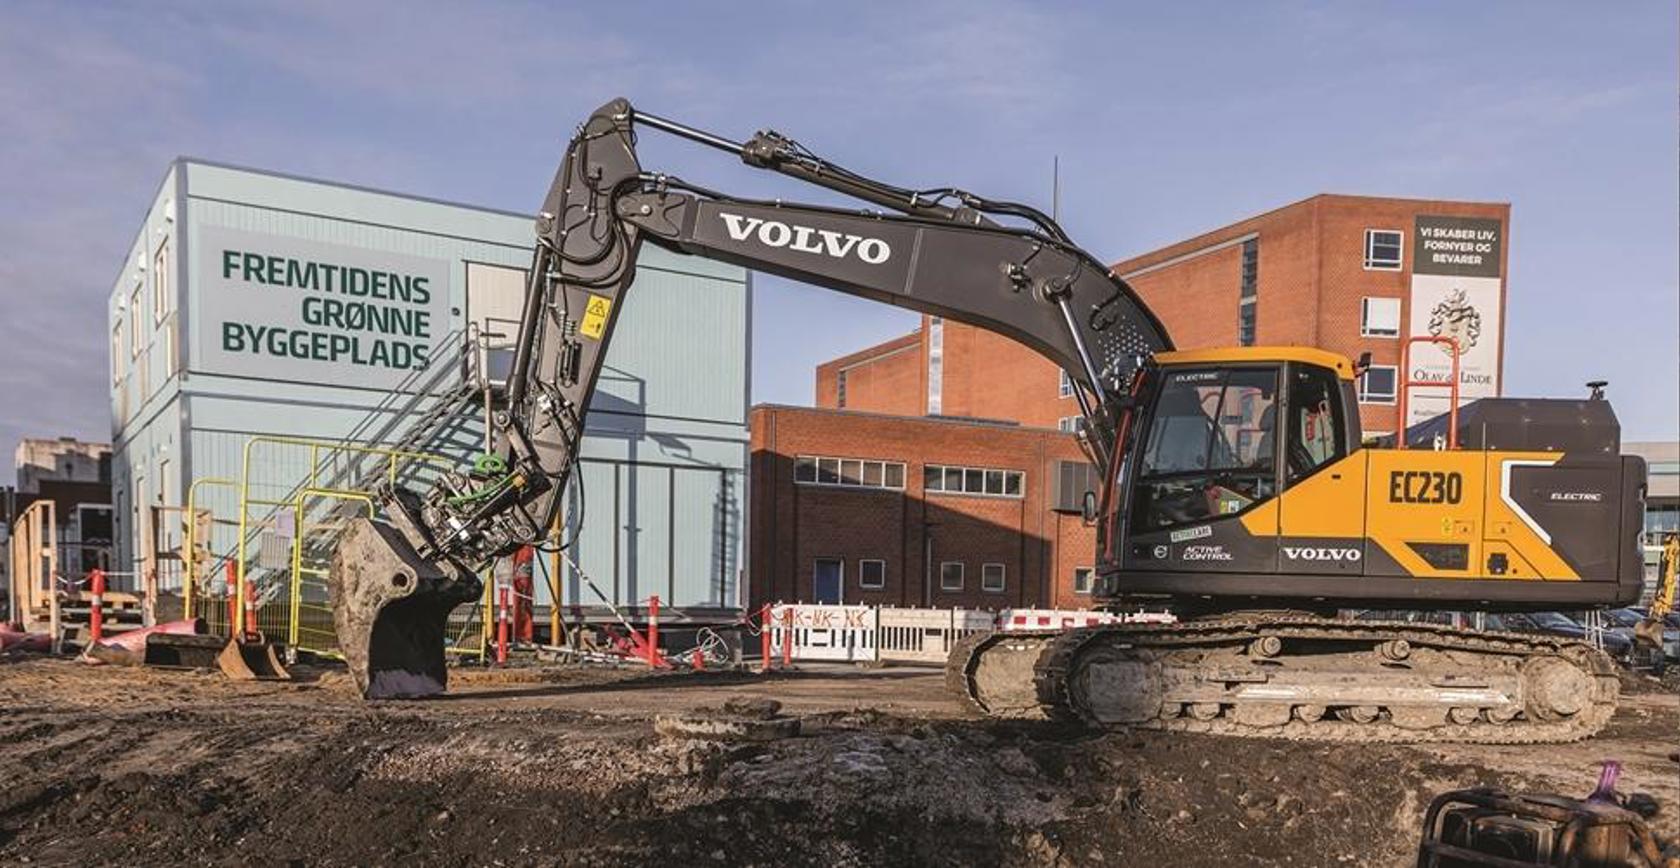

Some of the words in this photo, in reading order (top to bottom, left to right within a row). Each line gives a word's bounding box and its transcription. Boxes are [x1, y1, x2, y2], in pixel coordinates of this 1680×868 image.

[719, 212, 891, 265] VOLVO
[1420, 227, 1432, 237] VI
[1433, 228, 1475, 239] SKABER
[1477, 230, 1496, 242] LIV,
[1424, 240, 1474, 252] FORNYER
[1475, 243, 1491, 252] OG
[1432, 253, 1482, 265] BEVARER
[223, 249, 431, 305] FREMTIDENS
[302, 296, 431, 338] GRØNNE
[222, 321, 431, 371] BYGGEPLADS
[1175, 372, 1219, 382] ELECTRIC
[1389, 470, 1462, 504] EC230
[1550, 492, 1602, 501] ELECTRIC
[1183, 552, 1234, 561] CONTROL
[1184, 545, 1223, 554] ACTIVE
[1284, 547, 1361, 561] VOLVO
